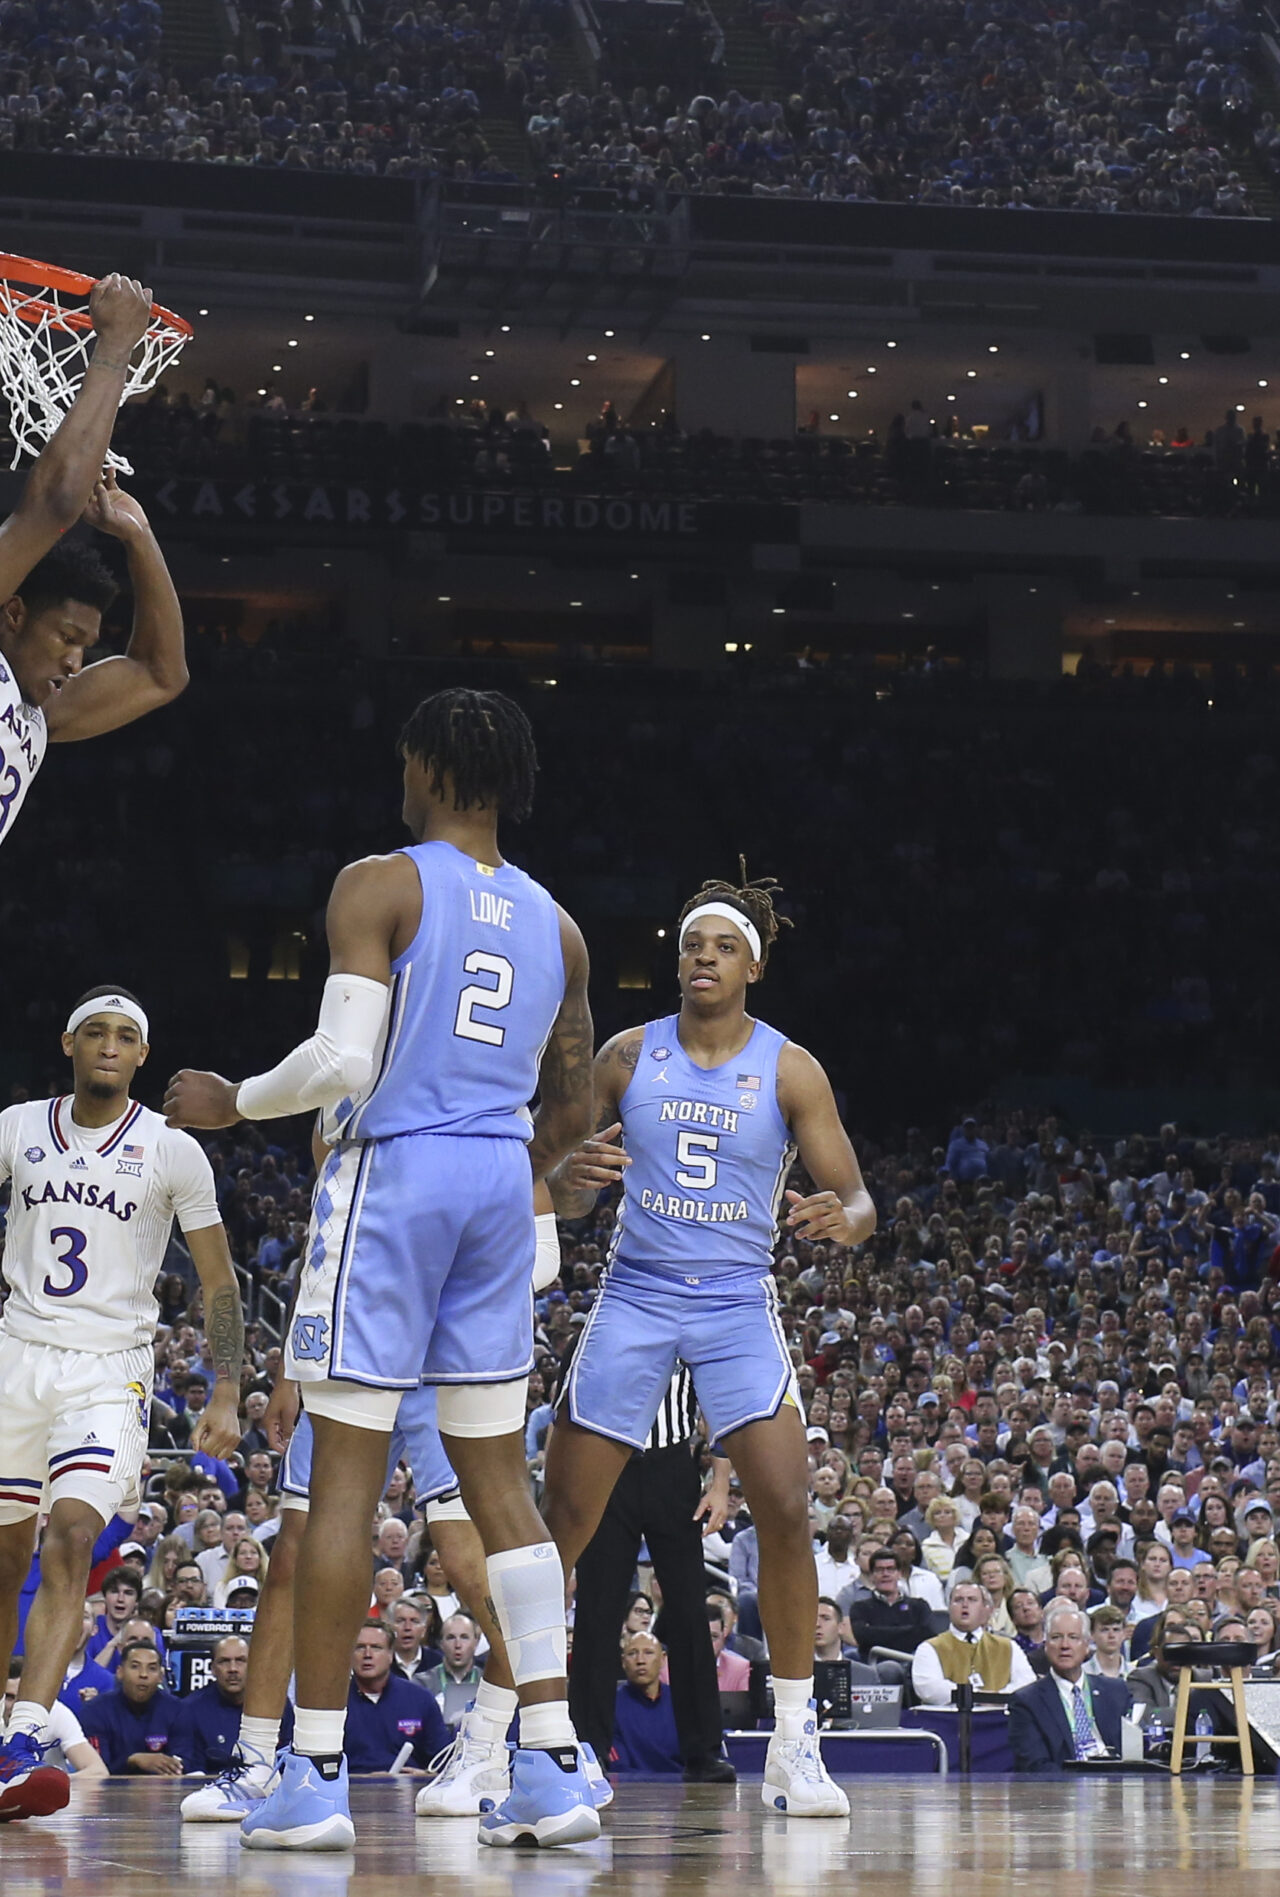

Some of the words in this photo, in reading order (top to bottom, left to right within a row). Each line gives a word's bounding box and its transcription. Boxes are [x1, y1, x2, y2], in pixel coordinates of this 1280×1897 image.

[154, 479, 407, 523] CAESARS
[419, 494, 698, 533] SUPERDOME
[470, 889, 514, 931] LOVE
[453, 949, 515, 1047] 2
[659, 1101, 738, 1133] NORTH
[675, 1131, 719, 1190] 5
[21, 1180, 137, 1222] KANSAS
[641, 1189, 748, 1222] CAROLINA
[43, 1226, 88, 1296] 3
[186, 1623, 234, 1632] POWERADE
